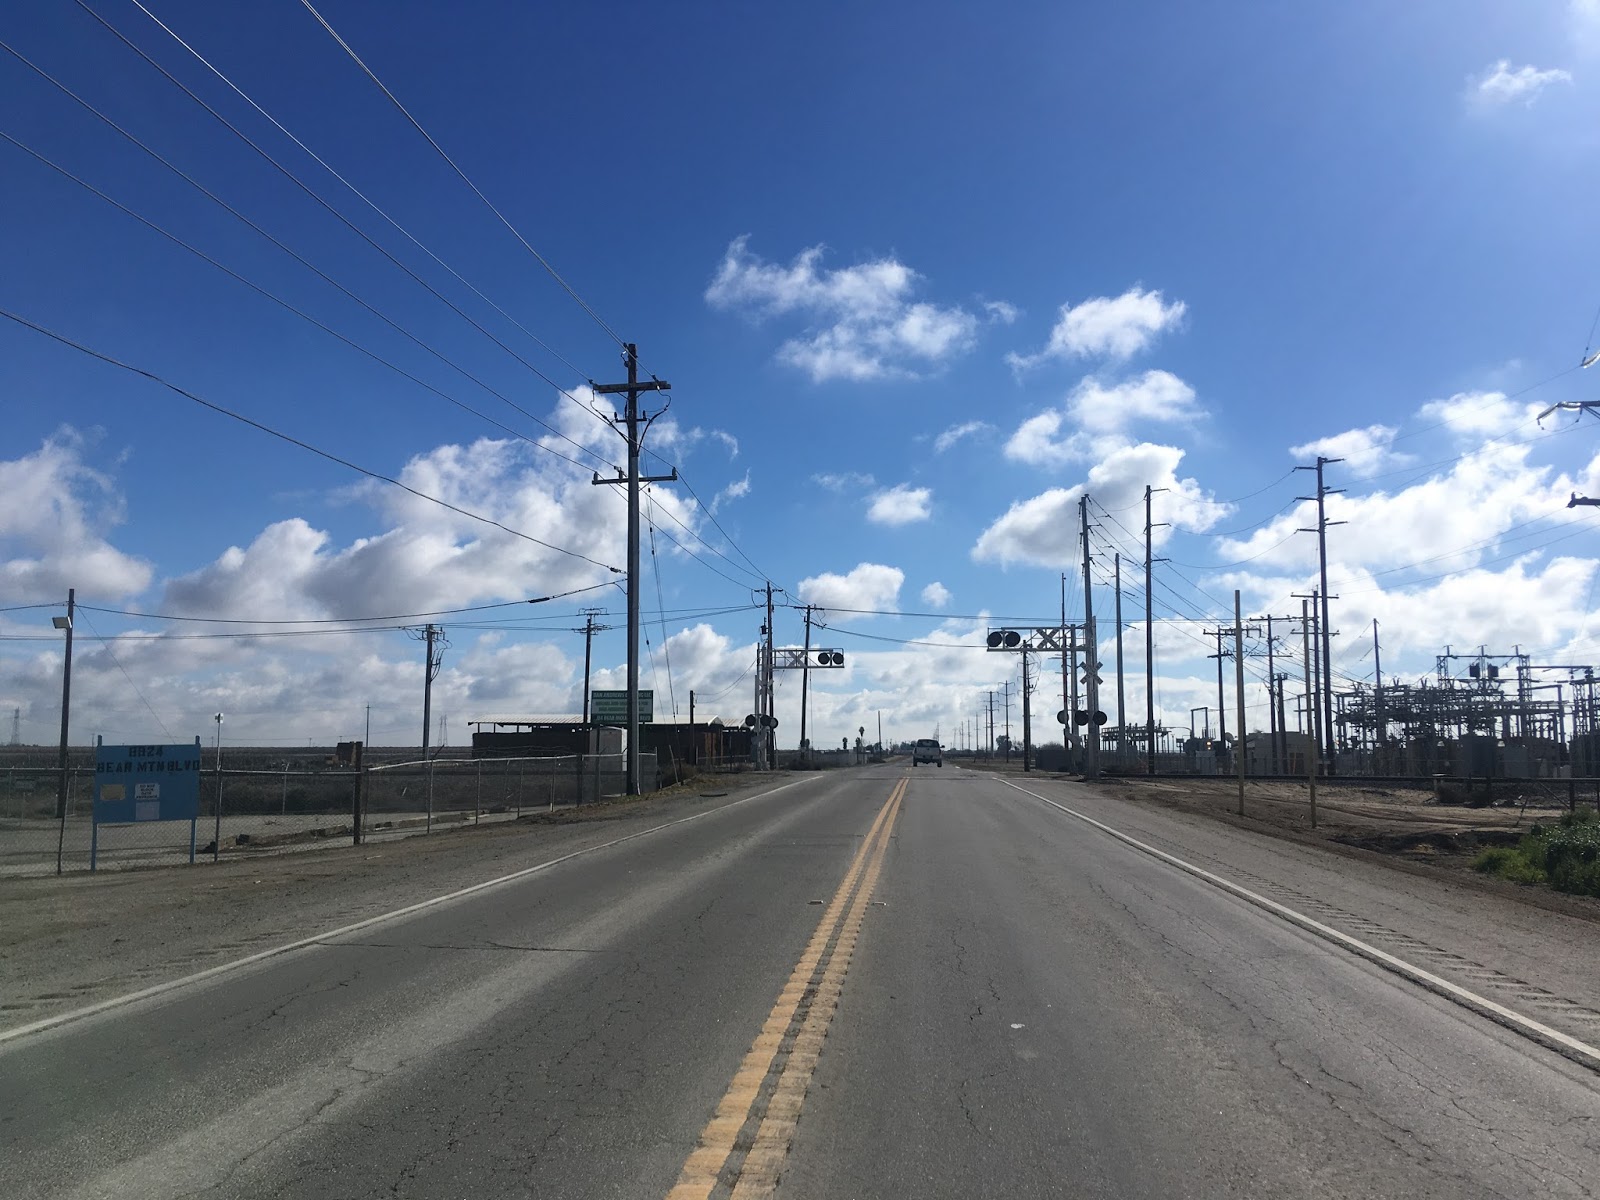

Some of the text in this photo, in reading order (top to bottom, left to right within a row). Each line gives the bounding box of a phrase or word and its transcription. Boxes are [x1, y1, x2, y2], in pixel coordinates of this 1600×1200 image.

[96, 760, 200, 773] BEAR MTN BLVD
